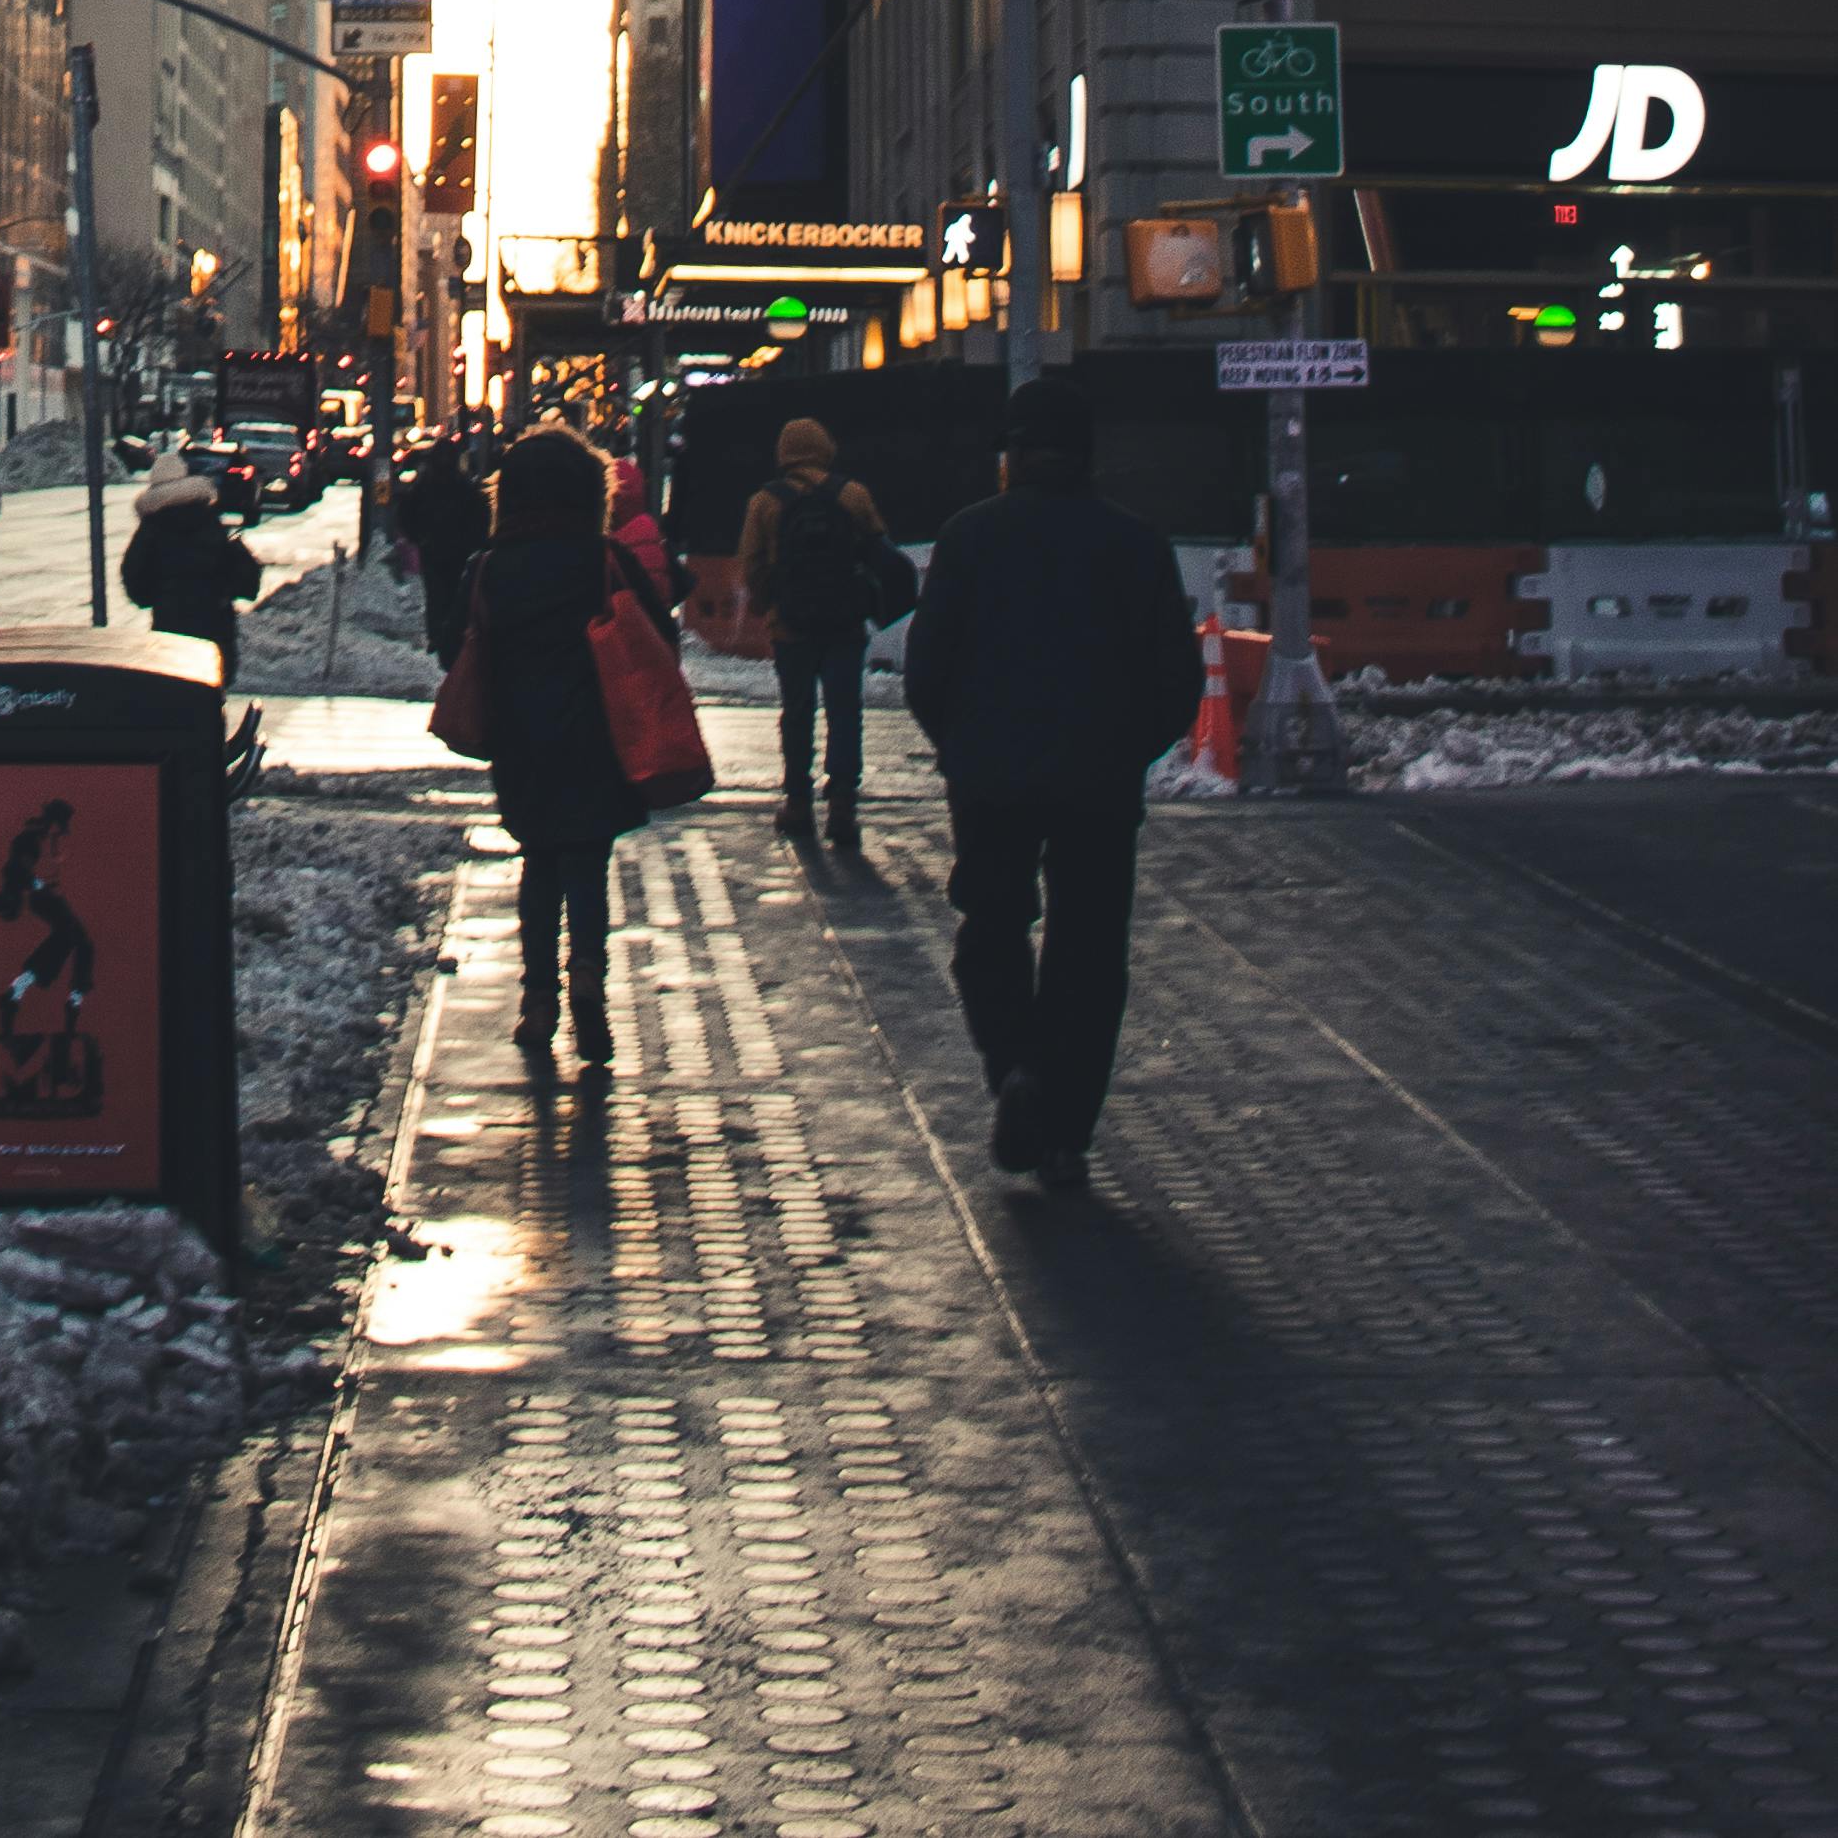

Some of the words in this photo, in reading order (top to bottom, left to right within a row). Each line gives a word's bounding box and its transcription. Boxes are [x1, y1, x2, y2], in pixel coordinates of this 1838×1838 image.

[1226, 89, 1334, 116] South
[1548, 63, 1706, 182] JD
[703, 220, 925, 248] KNICKERBOCKER
